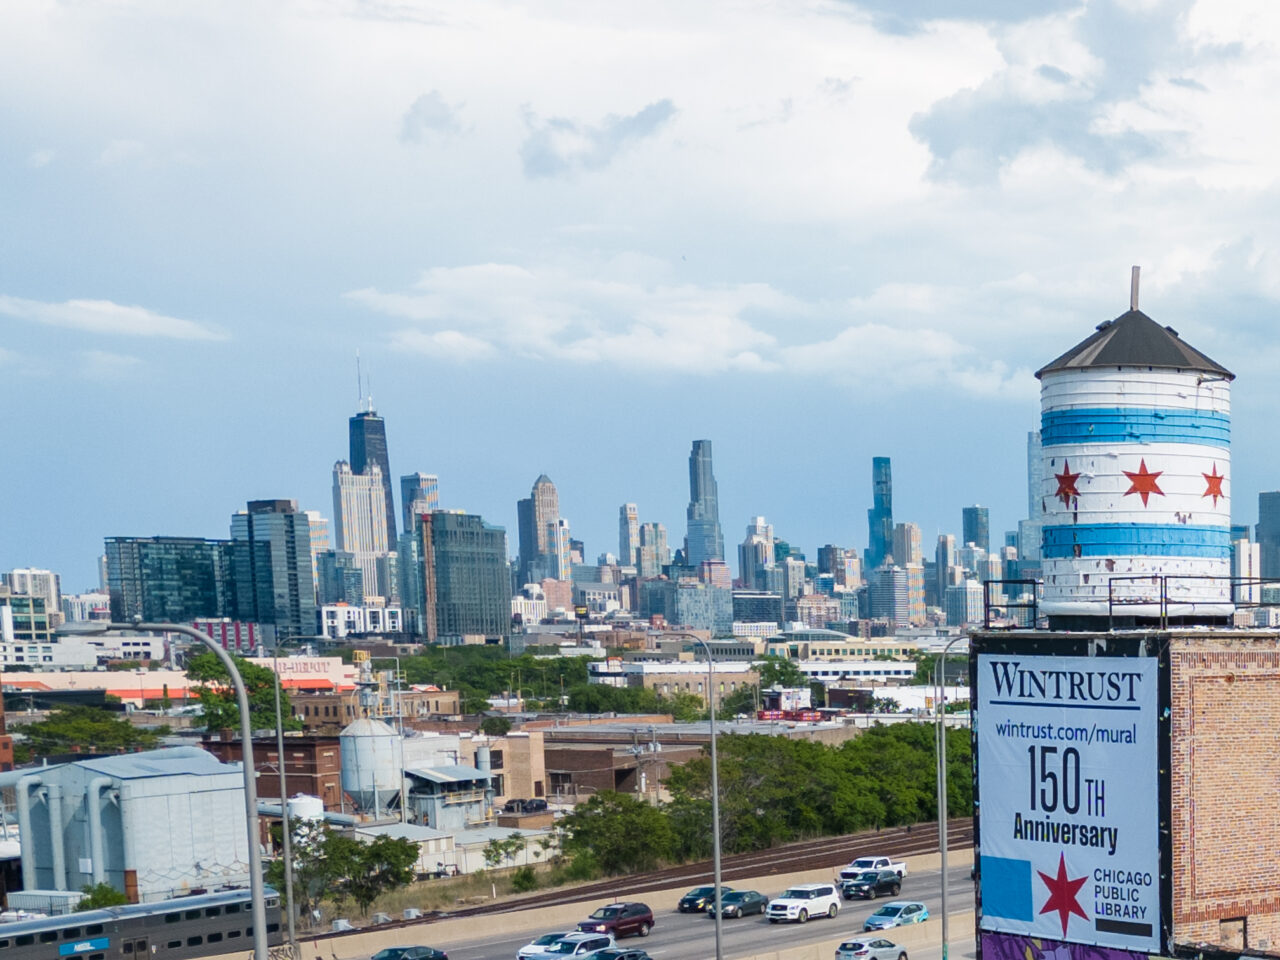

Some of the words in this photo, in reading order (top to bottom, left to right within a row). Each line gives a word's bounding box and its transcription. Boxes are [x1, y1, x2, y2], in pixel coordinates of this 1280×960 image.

[989, 661, 1142, 702] WINTRUST
[996, 719, 1137, 745] wintrust.com/mural
[1013, 812, 1118, 856] Anniversary
[1094, 868, 1152, 887] CHICAGO
[1094, 885, 1140, 902] PUBLIC
[1095, 902, 1147, 920] LIBRARY
